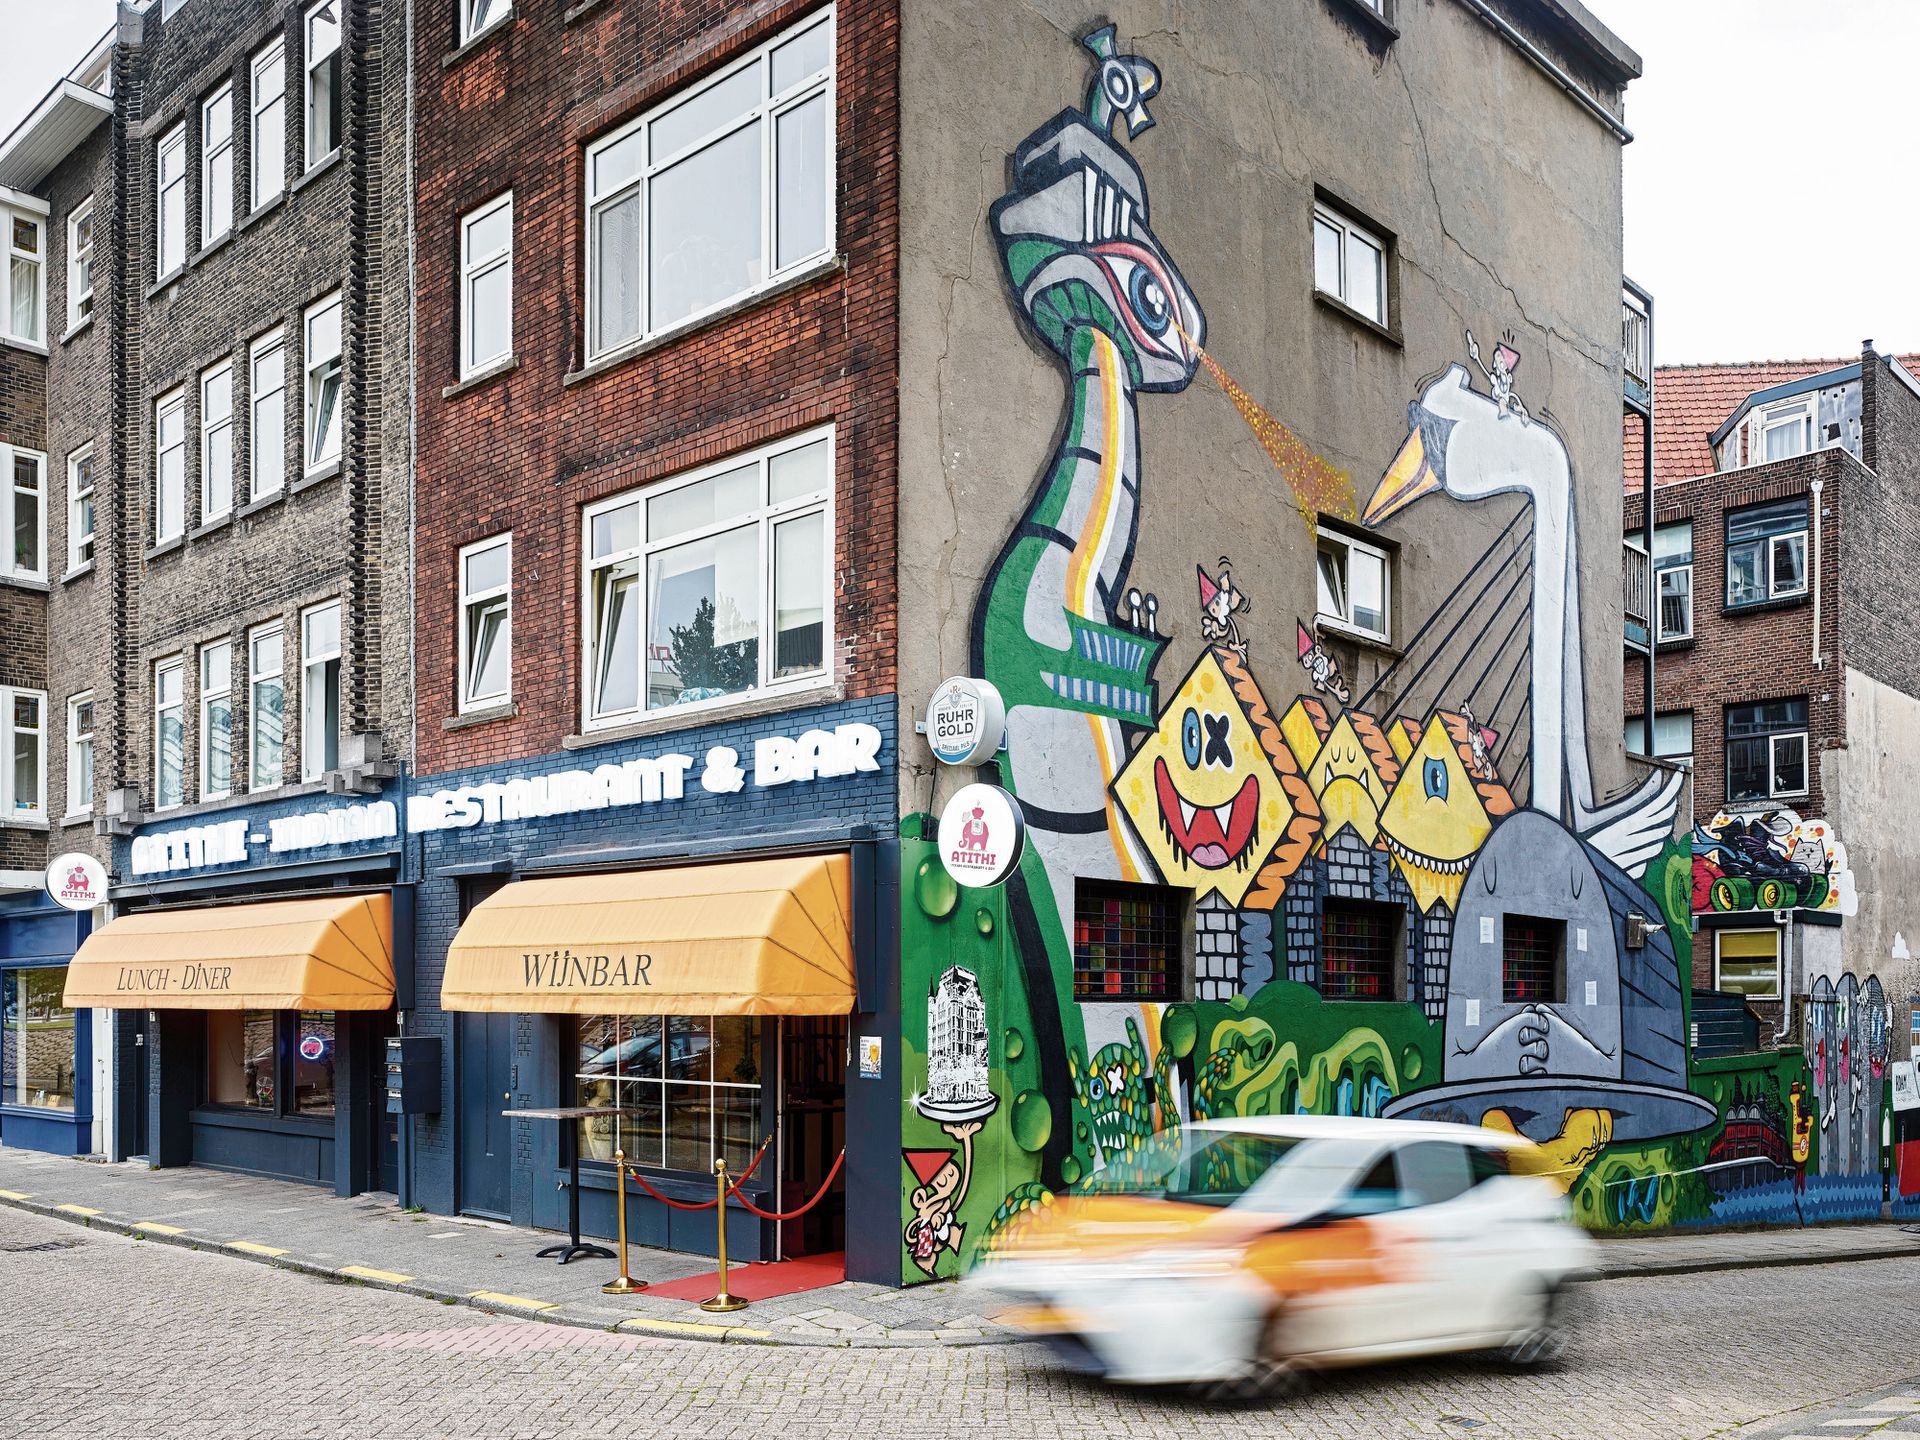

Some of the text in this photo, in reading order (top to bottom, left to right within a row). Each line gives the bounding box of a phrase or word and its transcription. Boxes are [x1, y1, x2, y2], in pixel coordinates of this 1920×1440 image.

[937, 709, 974, 724] RUHR
[937, 722, 974, 737] GOLD
[701, 746, 746, 794] &
[754, 722, 882, 787] BAR
[951, 851, 996, 865] ATITHI
[61, 890, 96, 899] ATITHI
